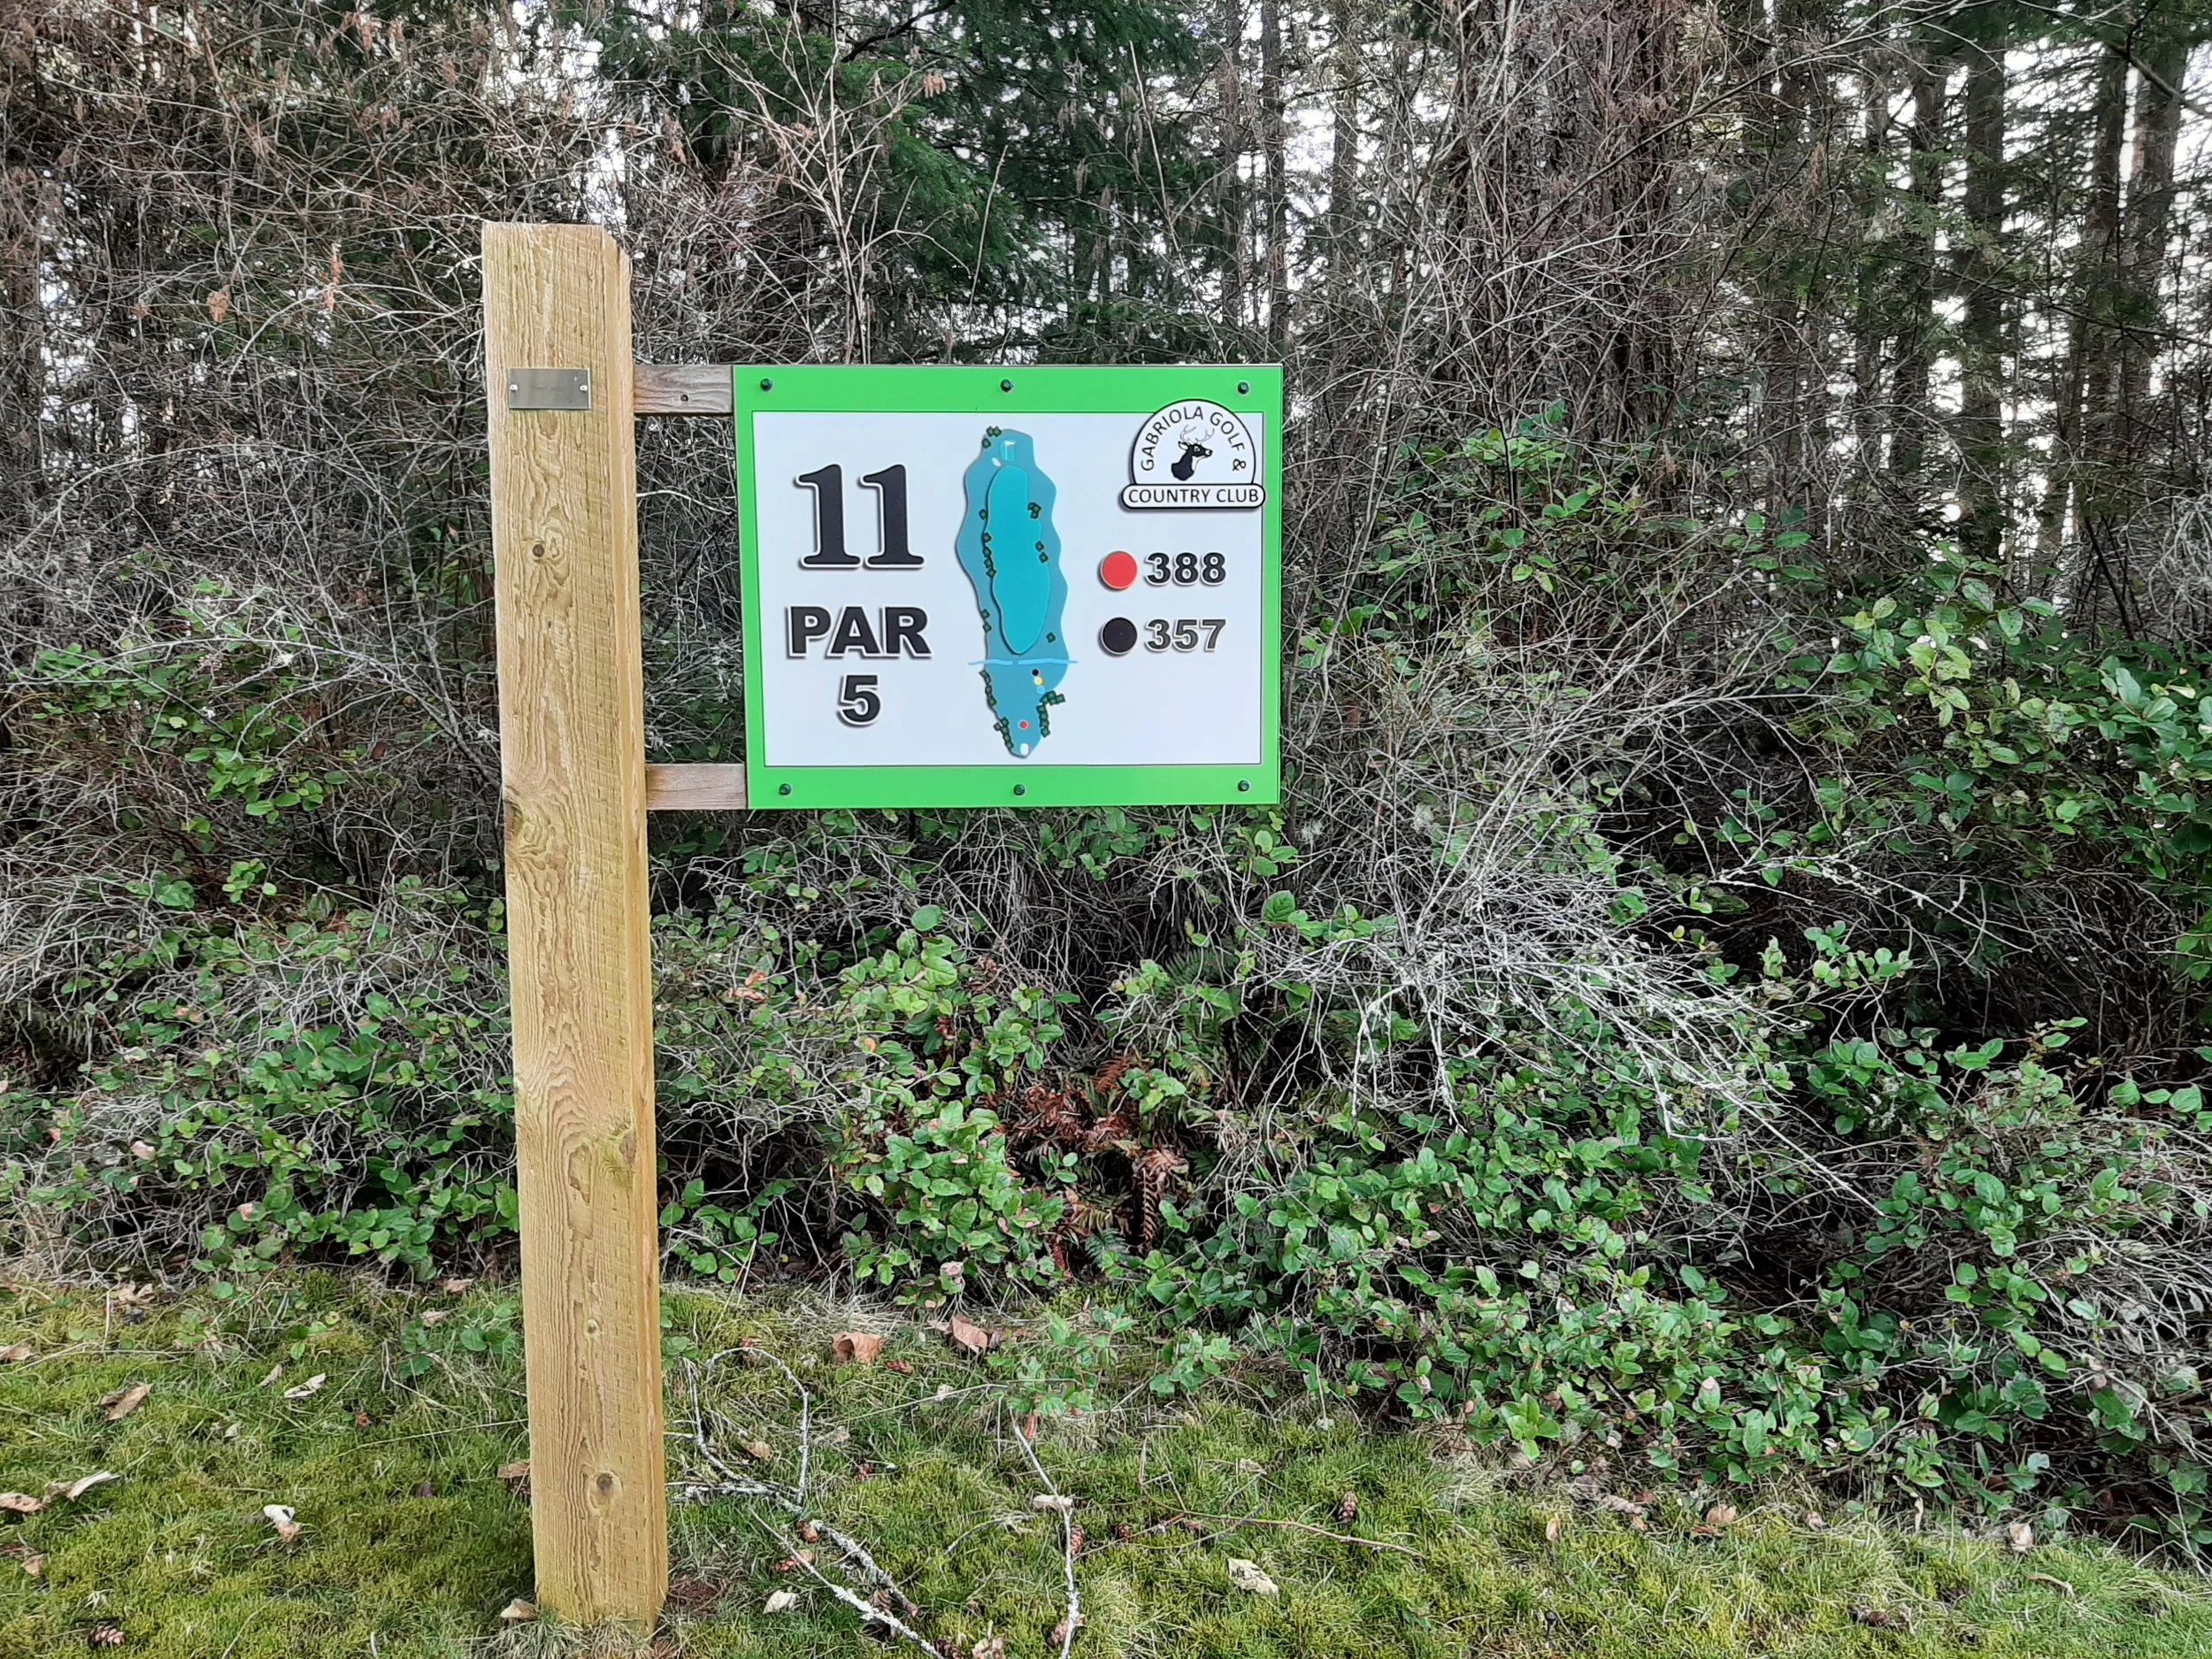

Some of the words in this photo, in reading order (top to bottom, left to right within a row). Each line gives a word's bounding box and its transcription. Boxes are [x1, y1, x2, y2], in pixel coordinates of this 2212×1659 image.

[1141, 406, 1204, 472] GABRIOLA
[1210, 411, 1246, 452] GOLF
[1232, 458, 1247, 472] &
[797, 464, 925, 566] 11
[1128, 488, 1210, 503] COUNTRY
[1217, 488, 1259, 503] CLUB
[1145, 552, 1227, 586] 388
[789, 606, 931, 656] PAR
[1144, 618, 1227, 651] 357
[840, 675, 881, 724] 5
